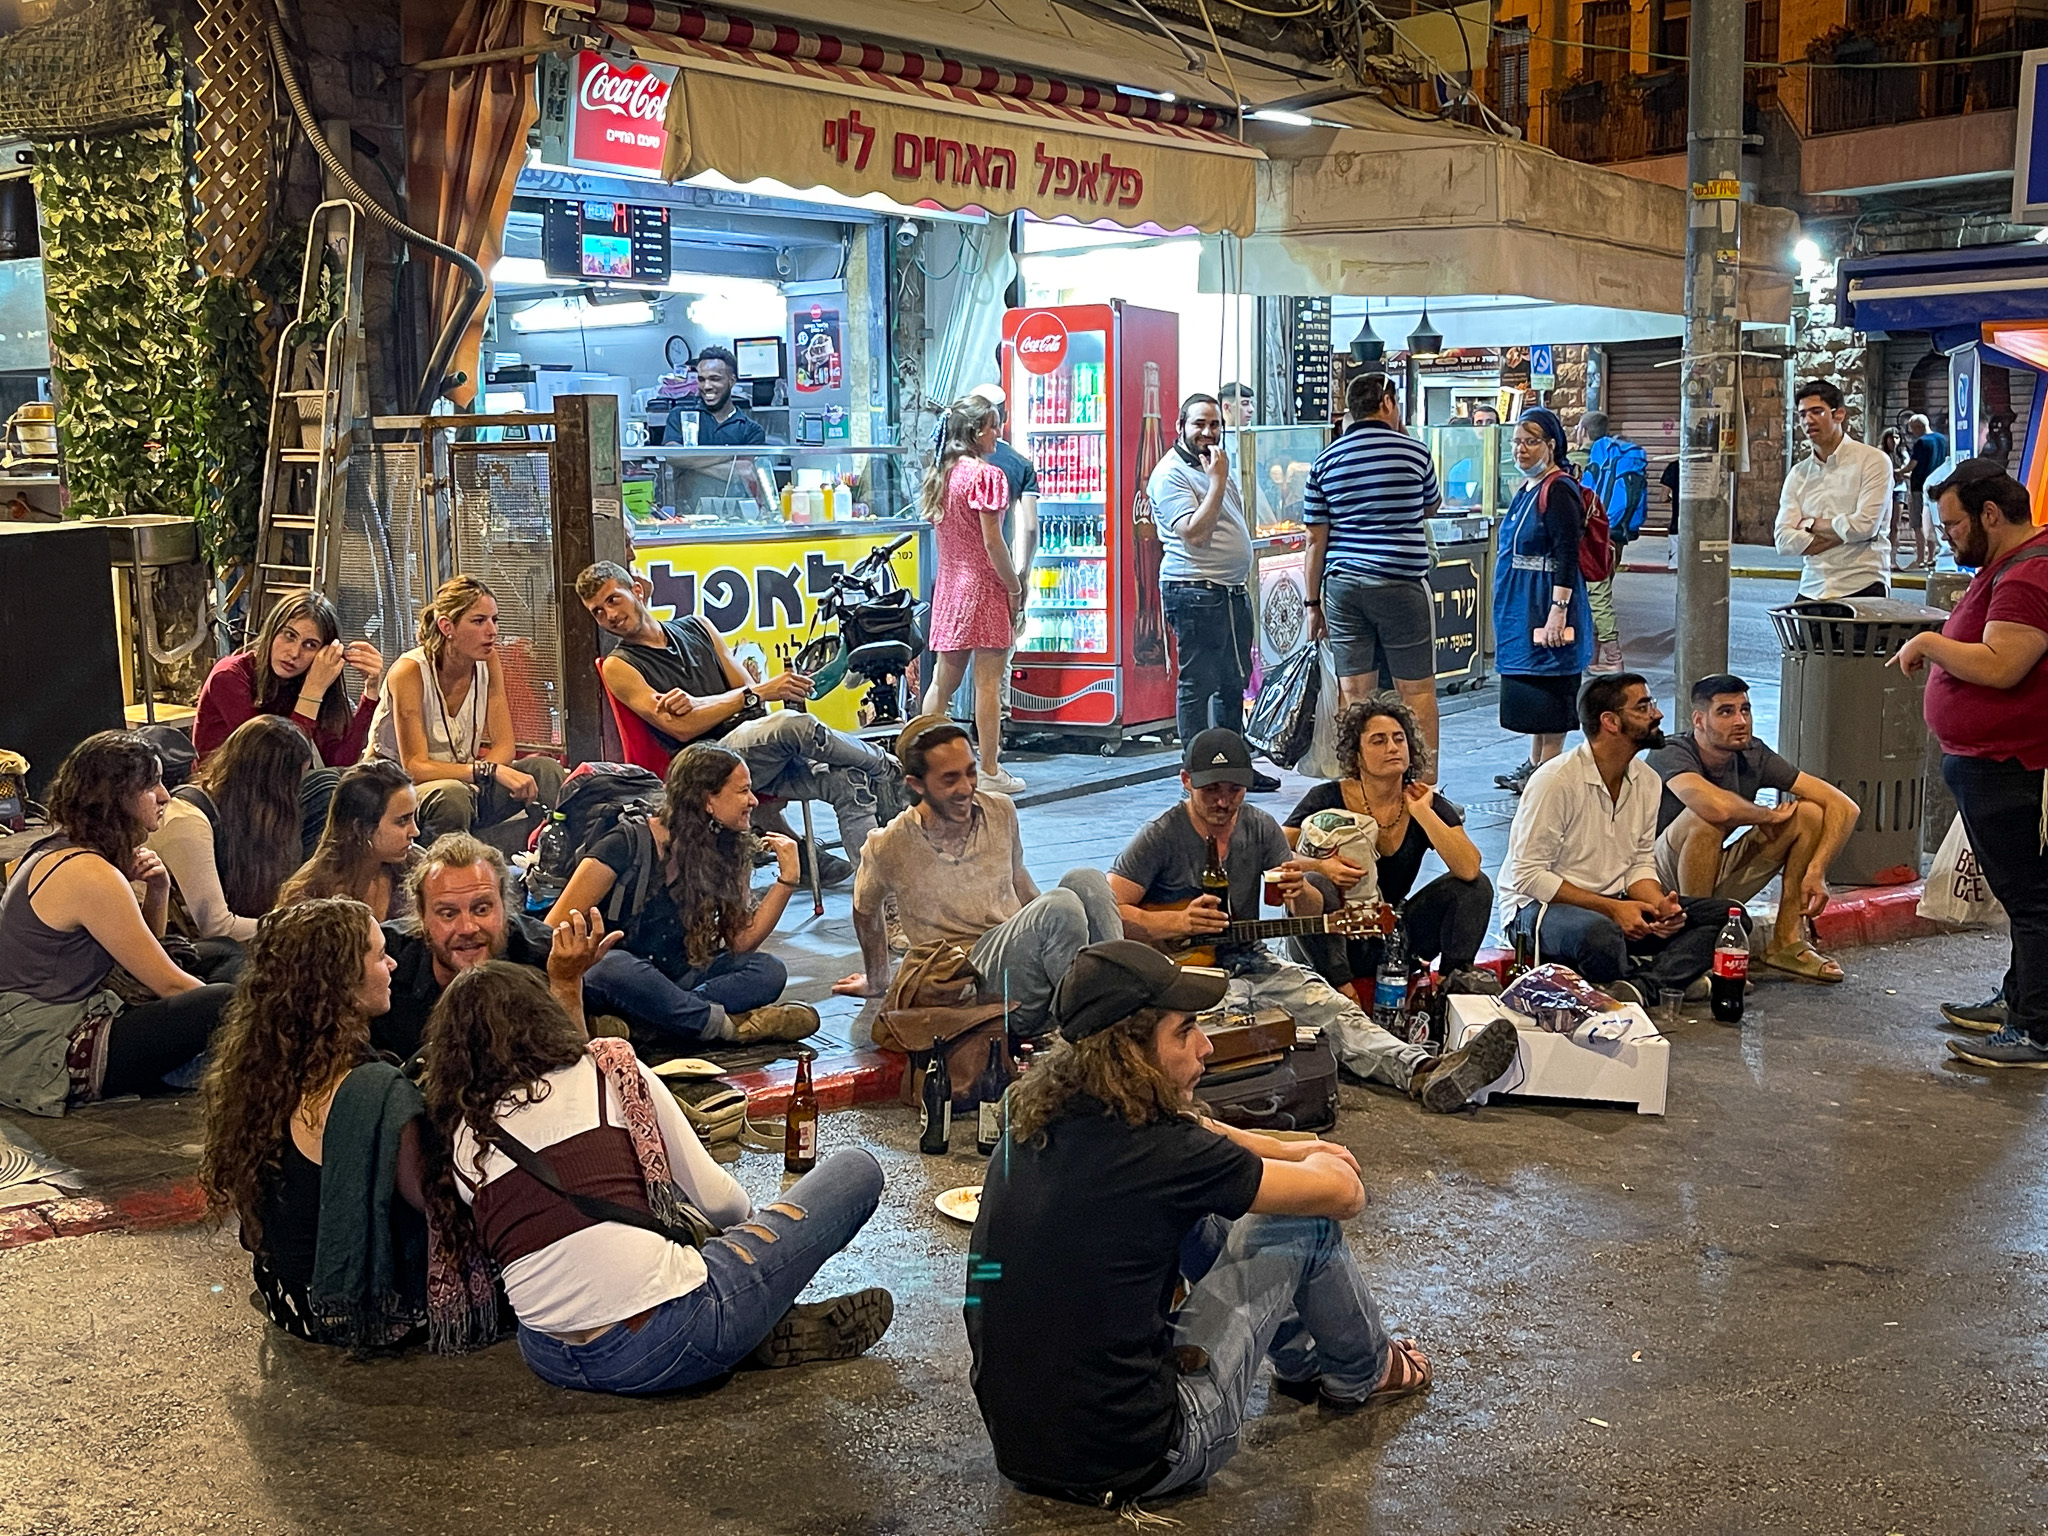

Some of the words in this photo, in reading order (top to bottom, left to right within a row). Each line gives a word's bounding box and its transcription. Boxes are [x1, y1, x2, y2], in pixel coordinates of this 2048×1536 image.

[581, 62, 672, 122] Coca-Col
[823, 110, 876, 172] לוי
[893, 131, 1018, 191] האחים
[1035, 141, 1144, 207] פלאפל
[650, 552, 891, 635] לאפל
[1450, 587, 1476, 620] עיר
